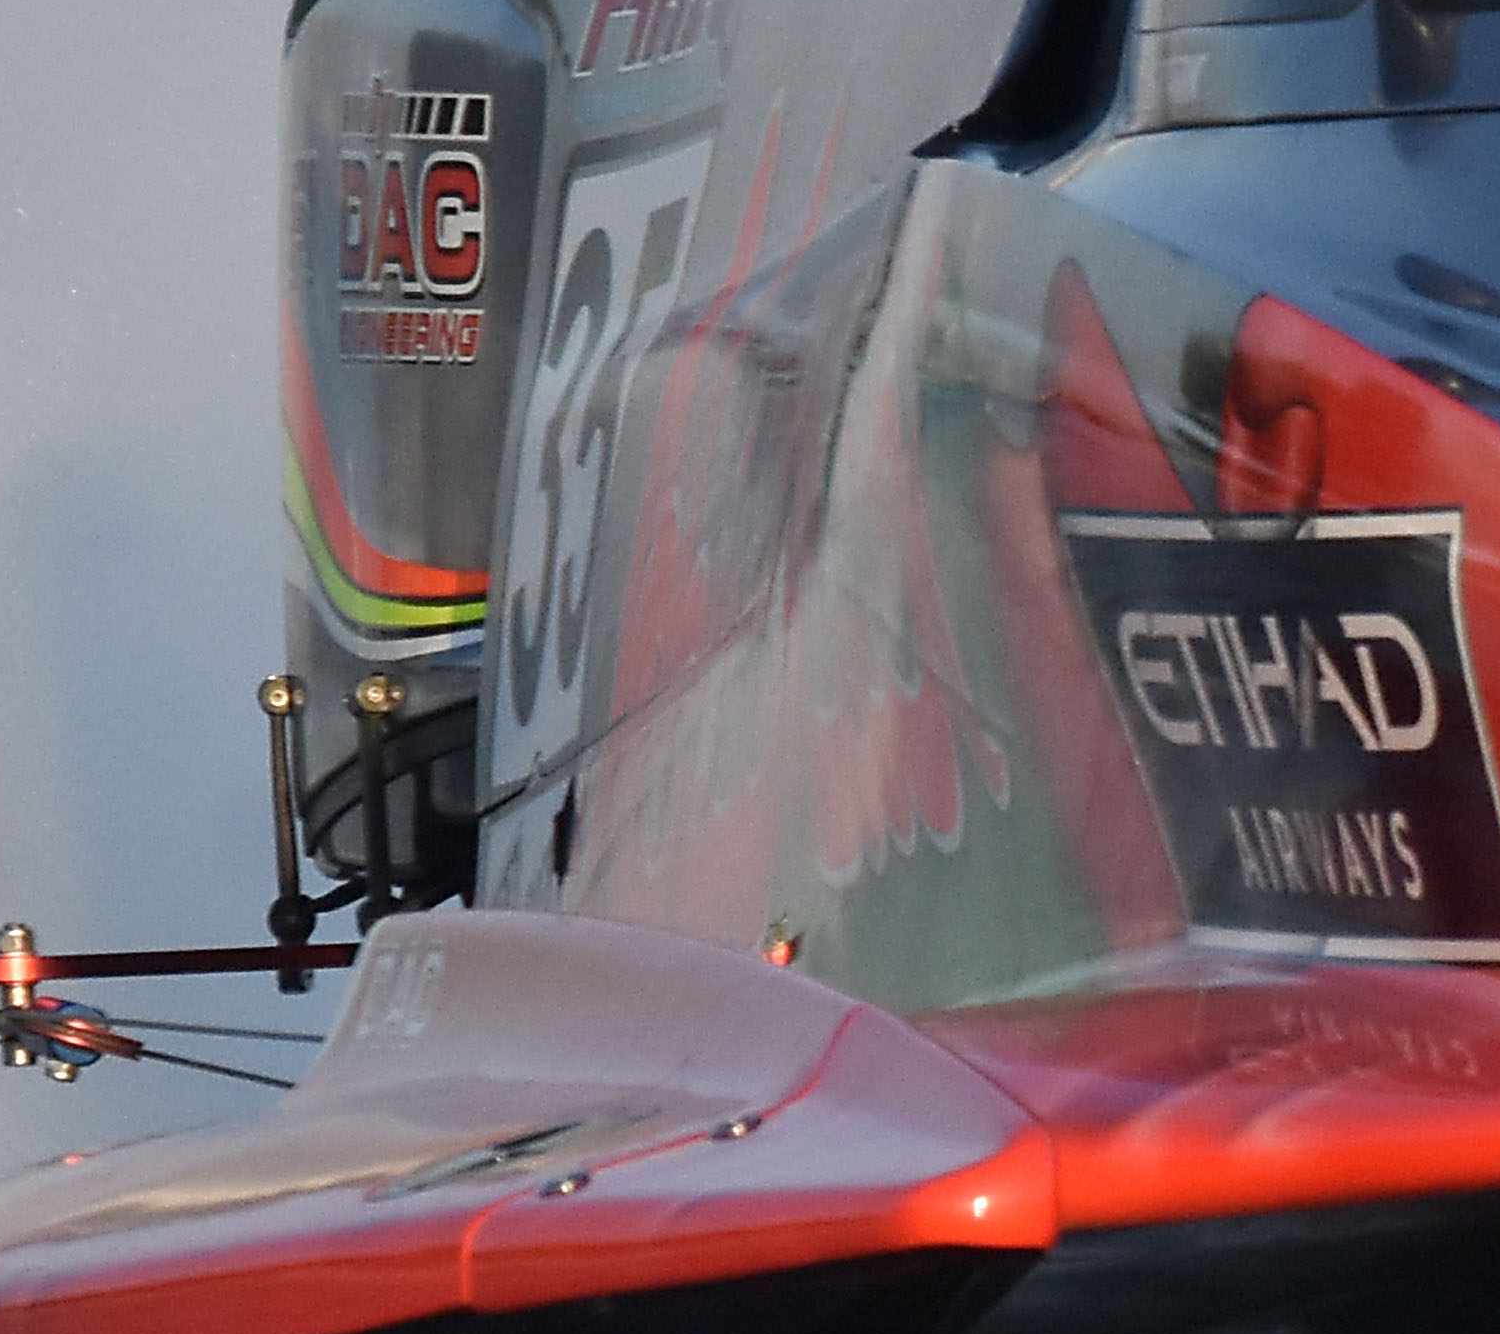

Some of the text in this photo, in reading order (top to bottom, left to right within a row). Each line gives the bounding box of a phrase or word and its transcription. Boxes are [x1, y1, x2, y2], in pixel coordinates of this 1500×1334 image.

[338, 150, 485, 297] DAC
[510, 195, 690, 728] 35
[1117, 611, 1442, 751] ETIHAD
[1228, 805, 1425, 901] AIRWAYS
